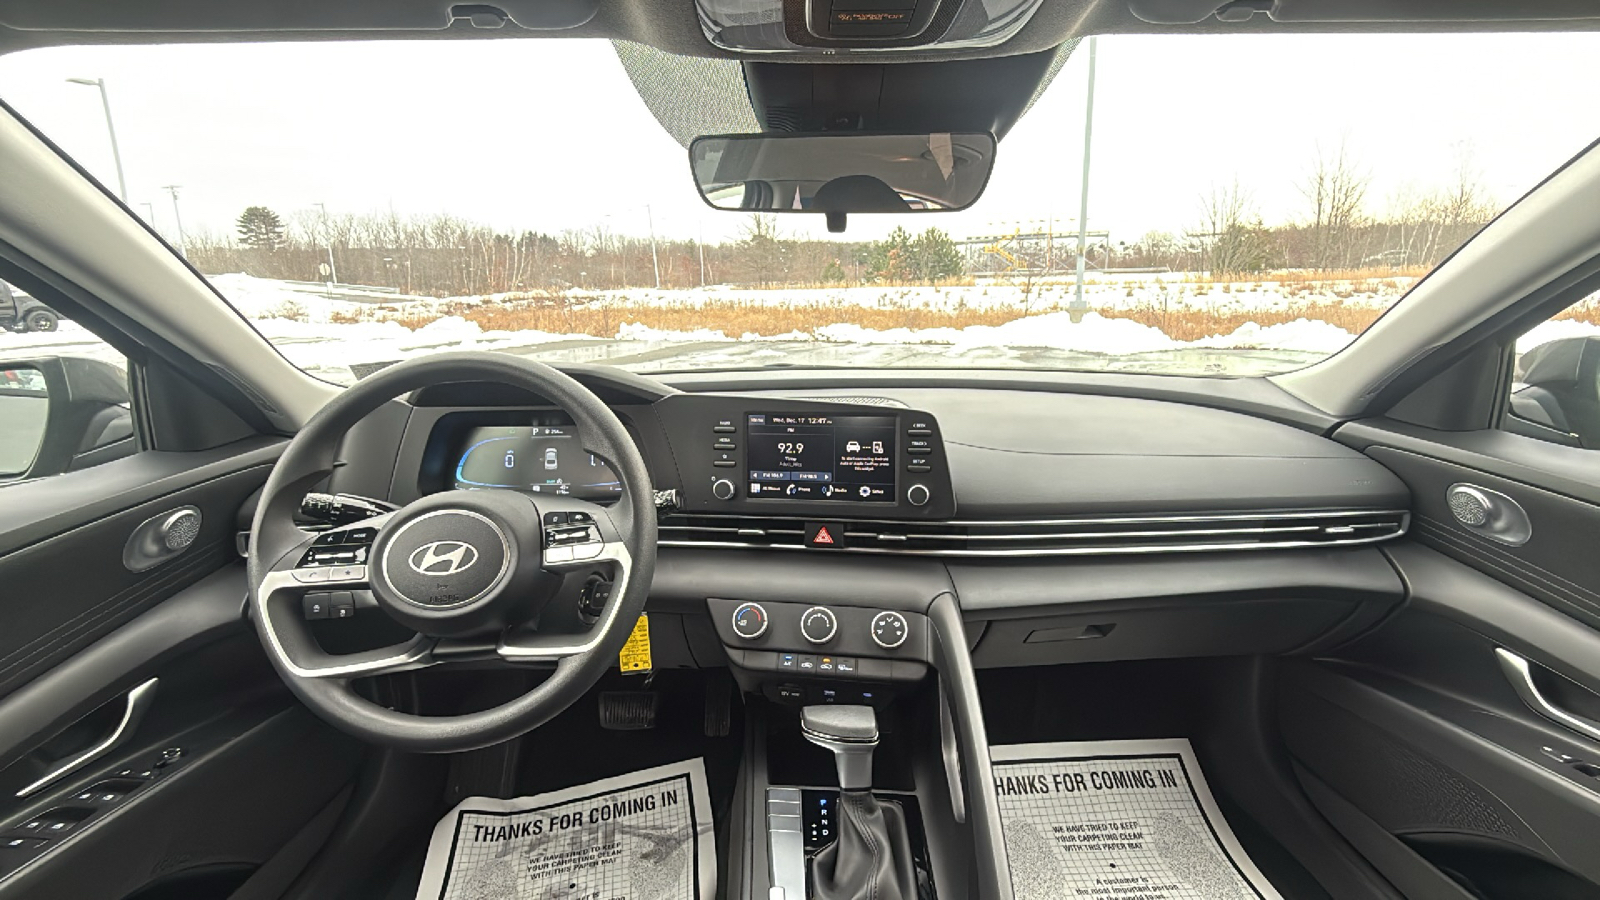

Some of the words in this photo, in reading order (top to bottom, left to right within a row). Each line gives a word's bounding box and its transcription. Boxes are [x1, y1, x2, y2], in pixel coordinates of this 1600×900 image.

[778, 443, 804, 454] 92.9
[995, 774, 1049, 796] HANKS
[1053, 773, 1087, 793] FOR
[1091, 770, 1156, 790] COMING
[1157, 770, 1177, 788] IN
[473, 820, 543, 842] THANKS
[550, 812, 583, 832] FOR
[590, 794, 656, 824] COMING
[662, 790, 678, 807] IN
[1066, 825, 1085, 833] HAVE
[1086, 824, 1107, 832] TRIED
[1108, 823, 1118, 831] TO
[1120, 822, 1138, 830] KEEP
[1055, 834, 1077, 842] YOUR
[1078, 833, 1118, 842] CARPETING
[1120, 832, 1144, 840] CLEAN
[543, 852, 564, 861] HAVE
[566, 849, 588, 858] TRIED
[602, 842, 621, 850] KEEP
[1084, 843, 1102, 851] THIS
[1102, 843, 1126, 851] PAPER
[527, 862, 549, 872] YOUR
[552, 854, 595, 867] CARPETING
[598, 850, 622, 858] CLEAN
[530, 870, 551, 880] WITH
[554, 866, 571, 875] THIS
[574, 861, 598, 870] PAPER
[1112, 886, 1150, 894] important
[1152, 884, 1179, 892] person
